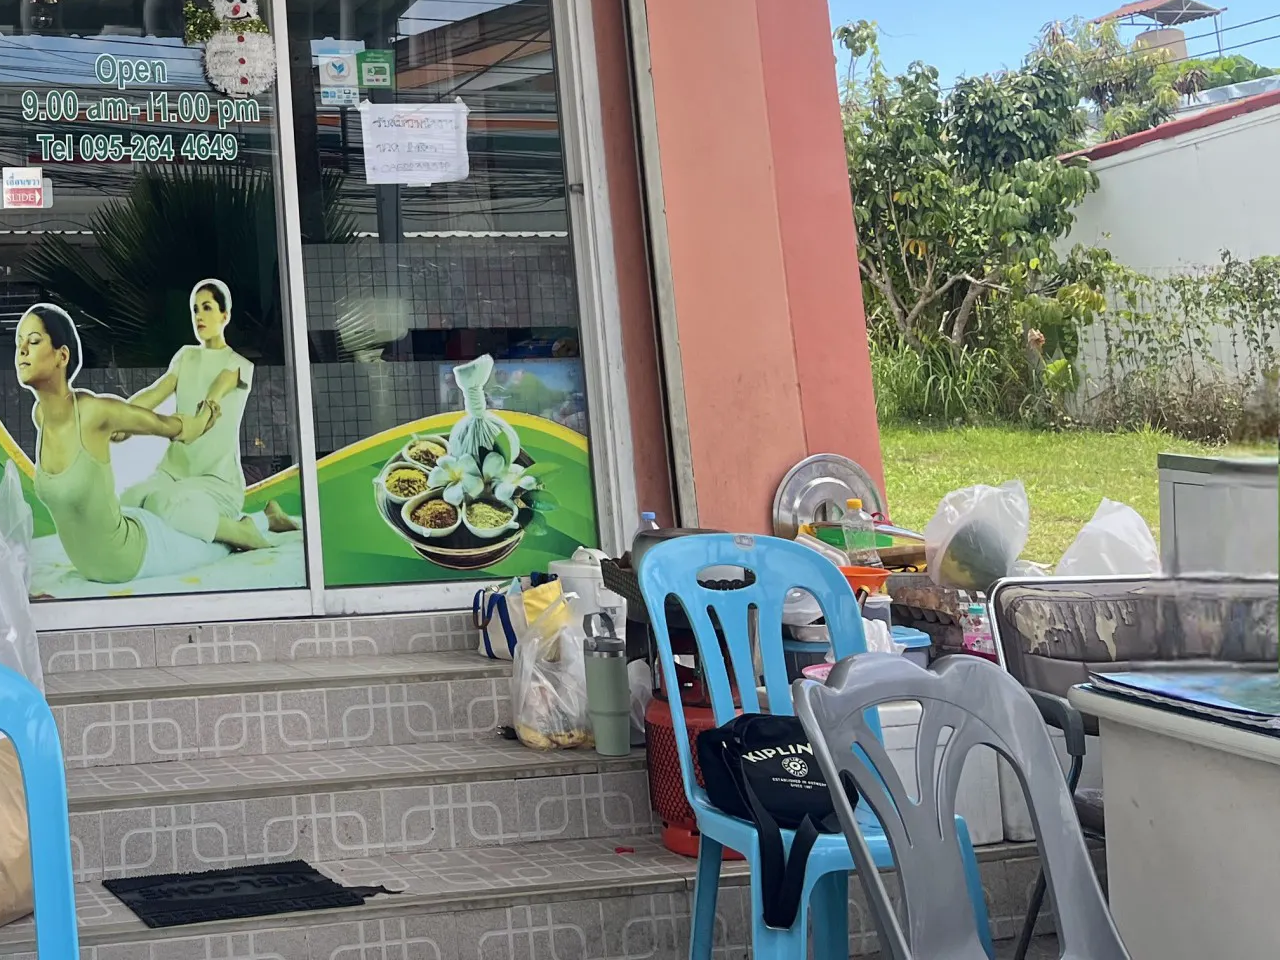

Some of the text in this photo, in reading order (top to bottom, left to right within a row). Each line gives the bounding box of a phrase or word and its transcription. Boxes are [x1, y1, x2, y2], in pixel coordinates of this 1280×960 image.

[95, 53, 168, 89] Open
[21, 89, 79, 122] 9.00
[217, 97, 260, 129] pm
[36, 133, 238, 162] Tel 095-264 4649
[6, 192, 36, 202] SLIDE
[741, 742, 814, 763] KIPLIN
